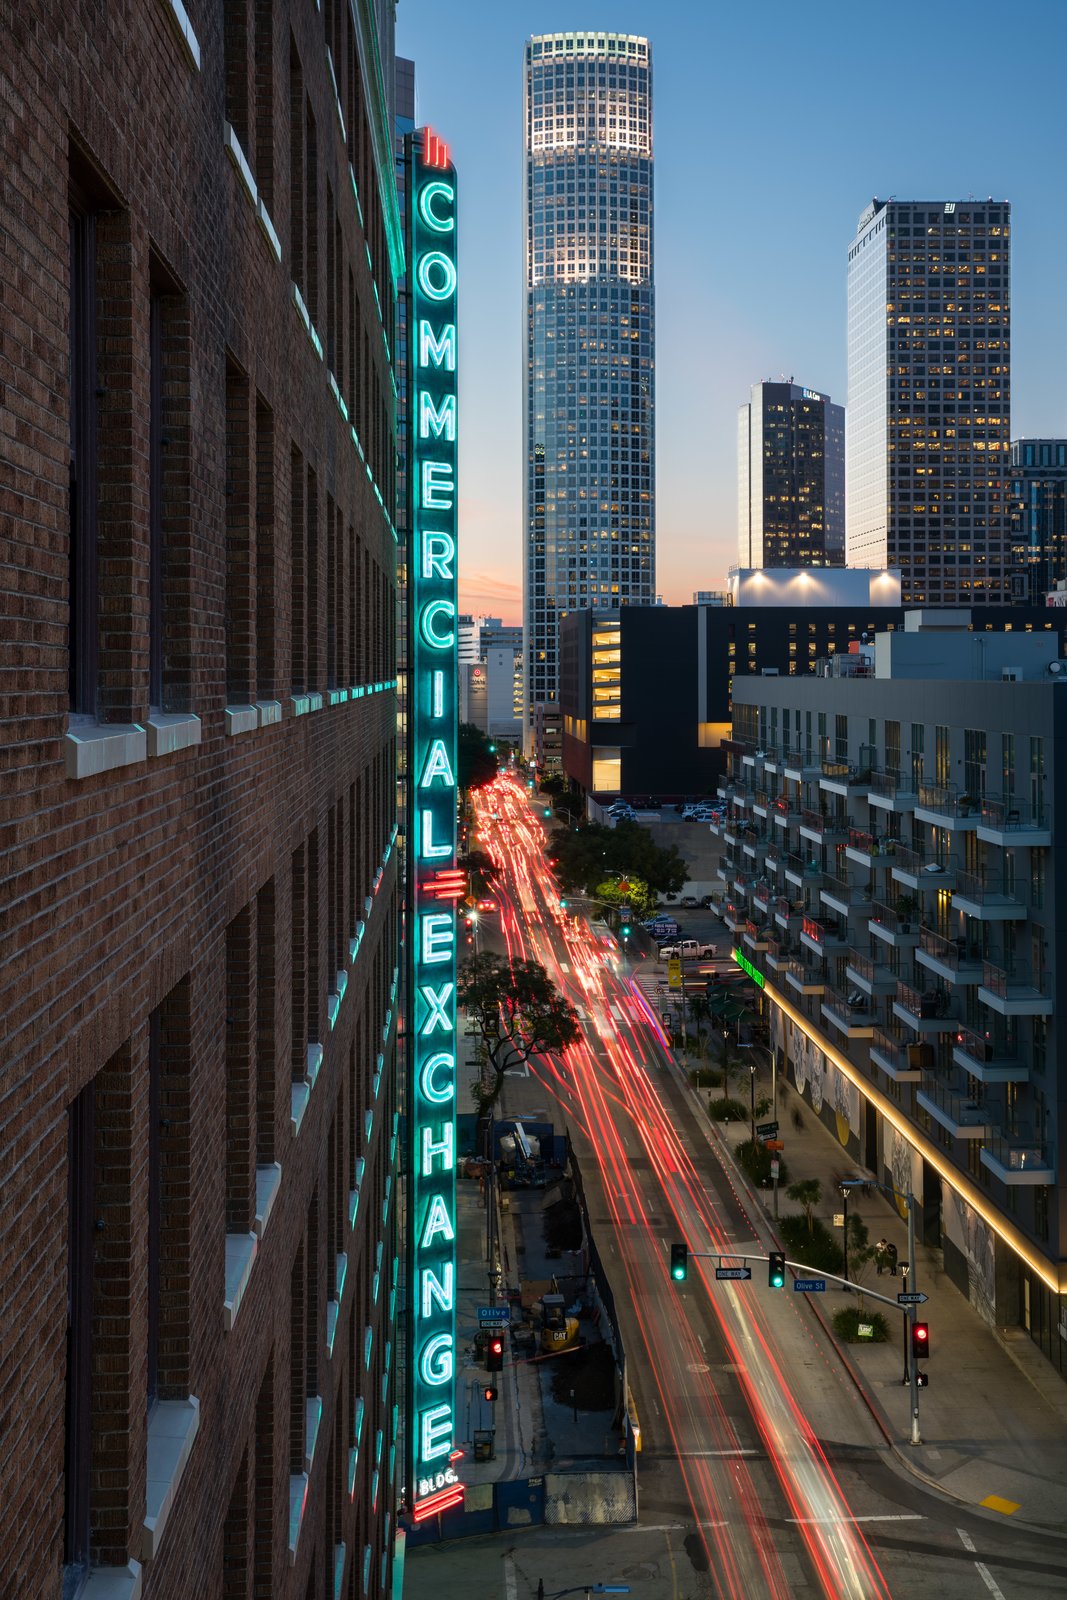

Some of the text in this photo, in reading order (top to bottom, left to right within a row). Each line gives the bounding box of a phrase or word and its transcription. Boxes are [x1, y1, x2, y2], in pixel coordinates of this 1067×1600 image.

[418, 181, 457, 1463] COMMERCIAL EXCHANGE
[730, 1270, 741, 1278] WAY
[796, 1281, 824, 1290] Olive St
[481, 1309, 506, 1317] Olive
[553, 1332, 567, 1341] CAT
[418, 1467, 459, 1496] BLDG.
